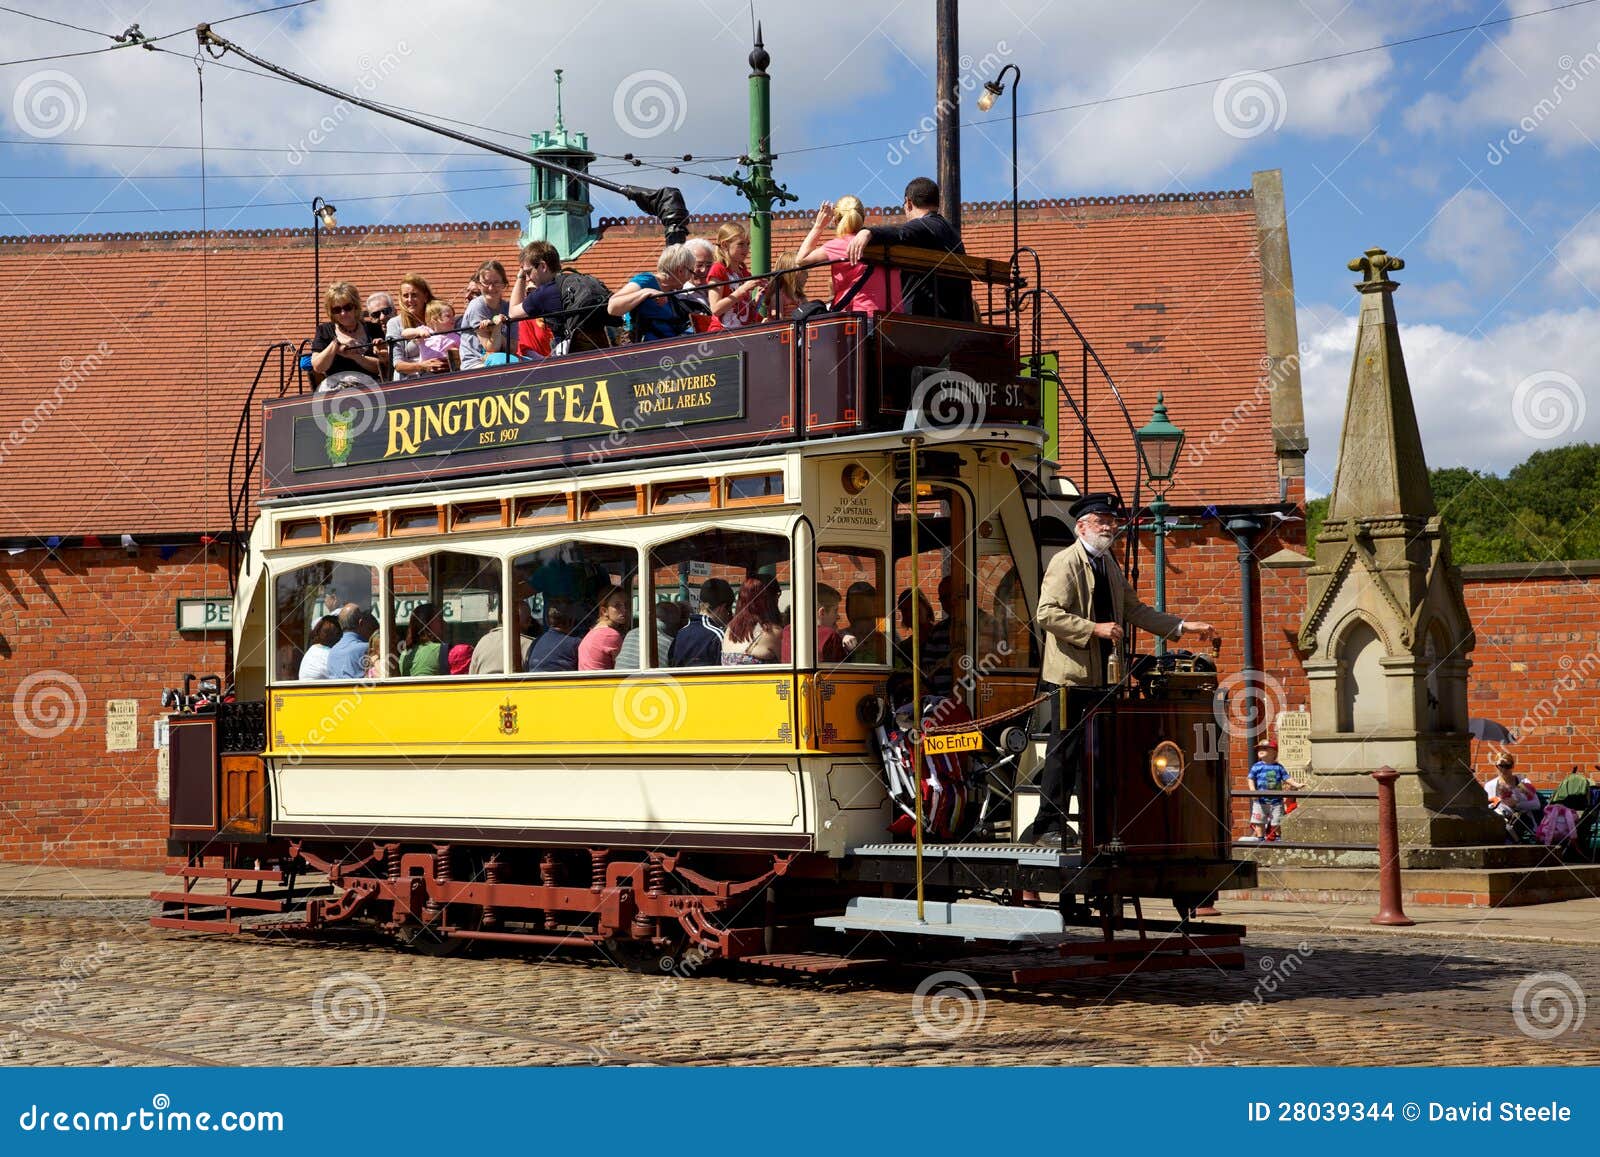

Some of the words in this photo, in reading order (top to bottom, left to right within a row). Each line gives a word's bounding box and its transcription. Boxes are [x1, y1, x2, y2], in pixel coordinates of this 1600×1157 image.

[633, 382, 655, 398] VAN
[657, 373, 717, 395] DELIVERIES
[940, 378, 998, 406] STANHOPE
[1005, 384, 1023, 407] ST.
[639, 399, 653, 414] TO
[654, 397, 674, 412] ALL
[676, 391, 711, 409] AREAS
[383, 391, 532, 459] RINGTONS
[538, 379, 620, 429] TEA
[479, 432, 496, 444] EST.
[500, 428, 519, 443] 1907
[837, 515, 878, 526] DOWNSTAIRS
[927, 738, 944, 751] No
[947, 735, 979, 749] Entry
